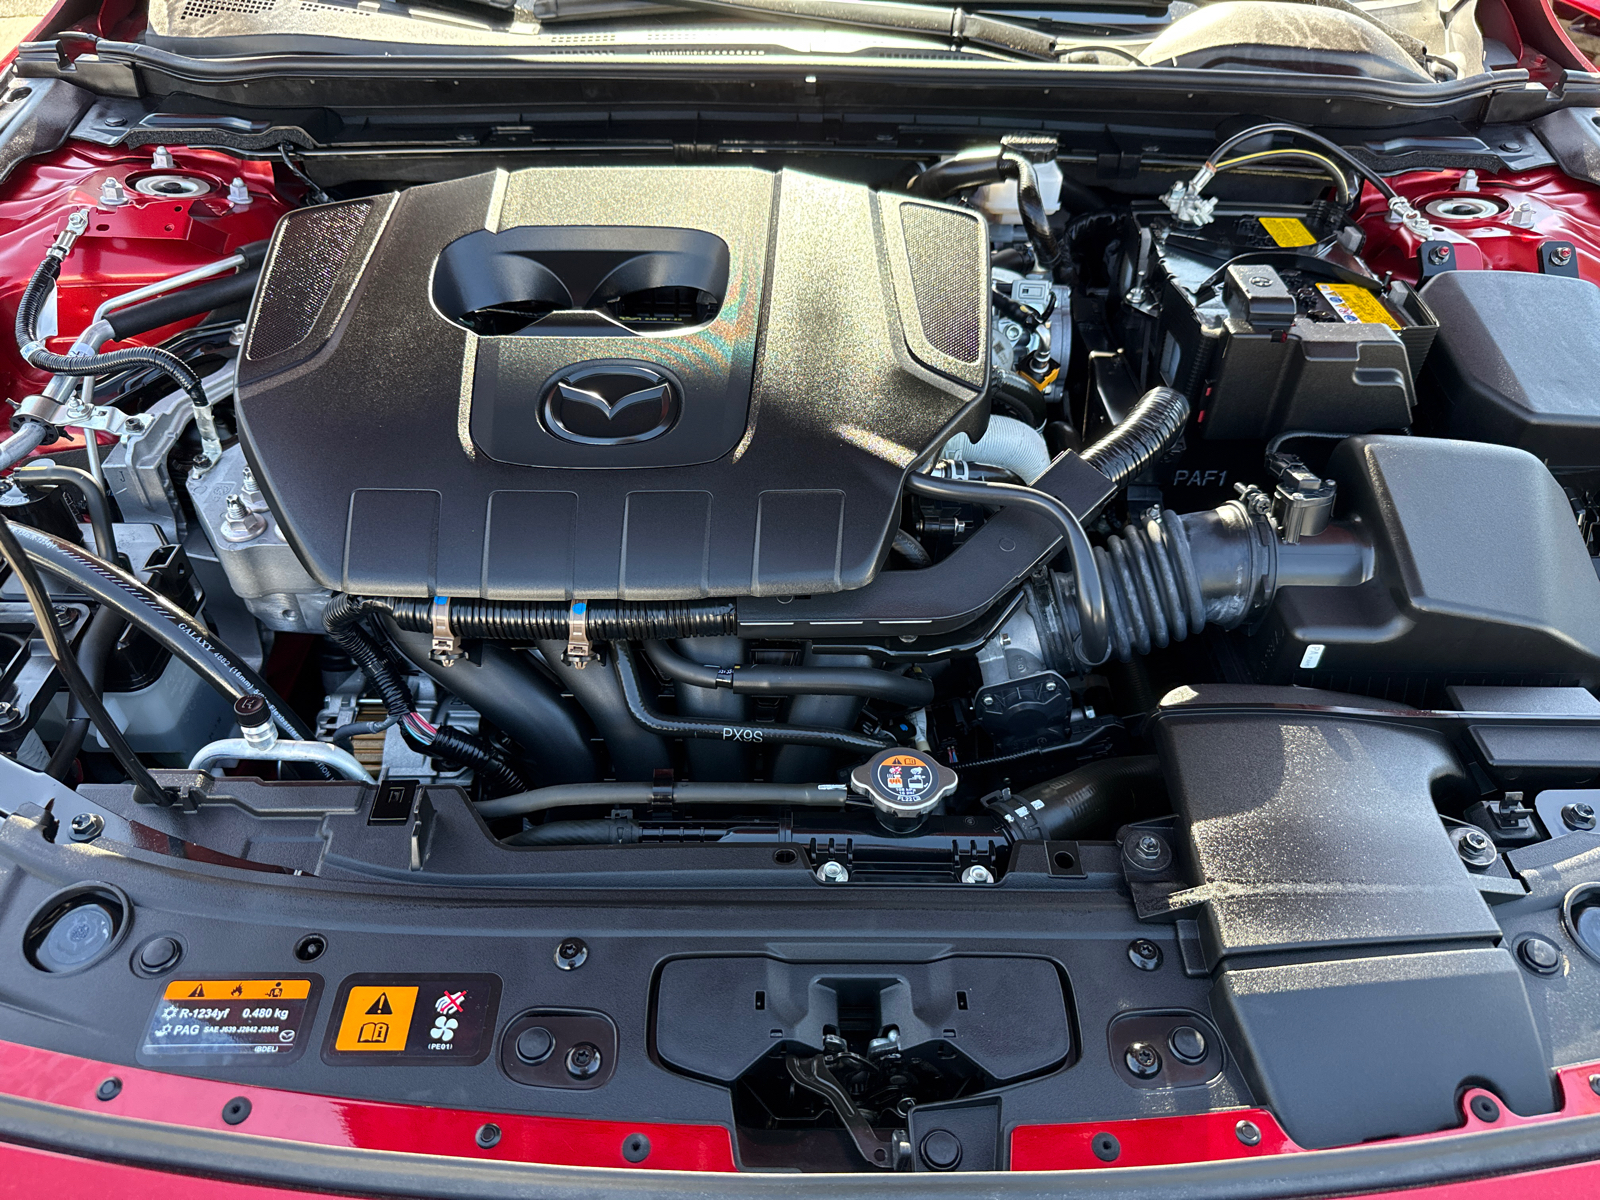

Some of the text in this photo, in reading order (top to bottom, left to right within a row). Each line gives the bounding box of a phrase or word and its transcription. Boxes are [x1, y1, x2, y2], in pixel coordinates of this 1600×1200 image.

[1173, 469, 1227, 487] PAF1
[178, 622, 215, 652] GALAXY
[213, 651, 230, 668] 4882
[229, 666, 254, 691] (16mm)
[268, 704, 299, 739] Flexbarrier
[722, 727, 763, 743] PX9S
[179, 1007, 289, 1020] R-1234yf 0.480 kg
[173, 1024, 200, 1036] PAG
